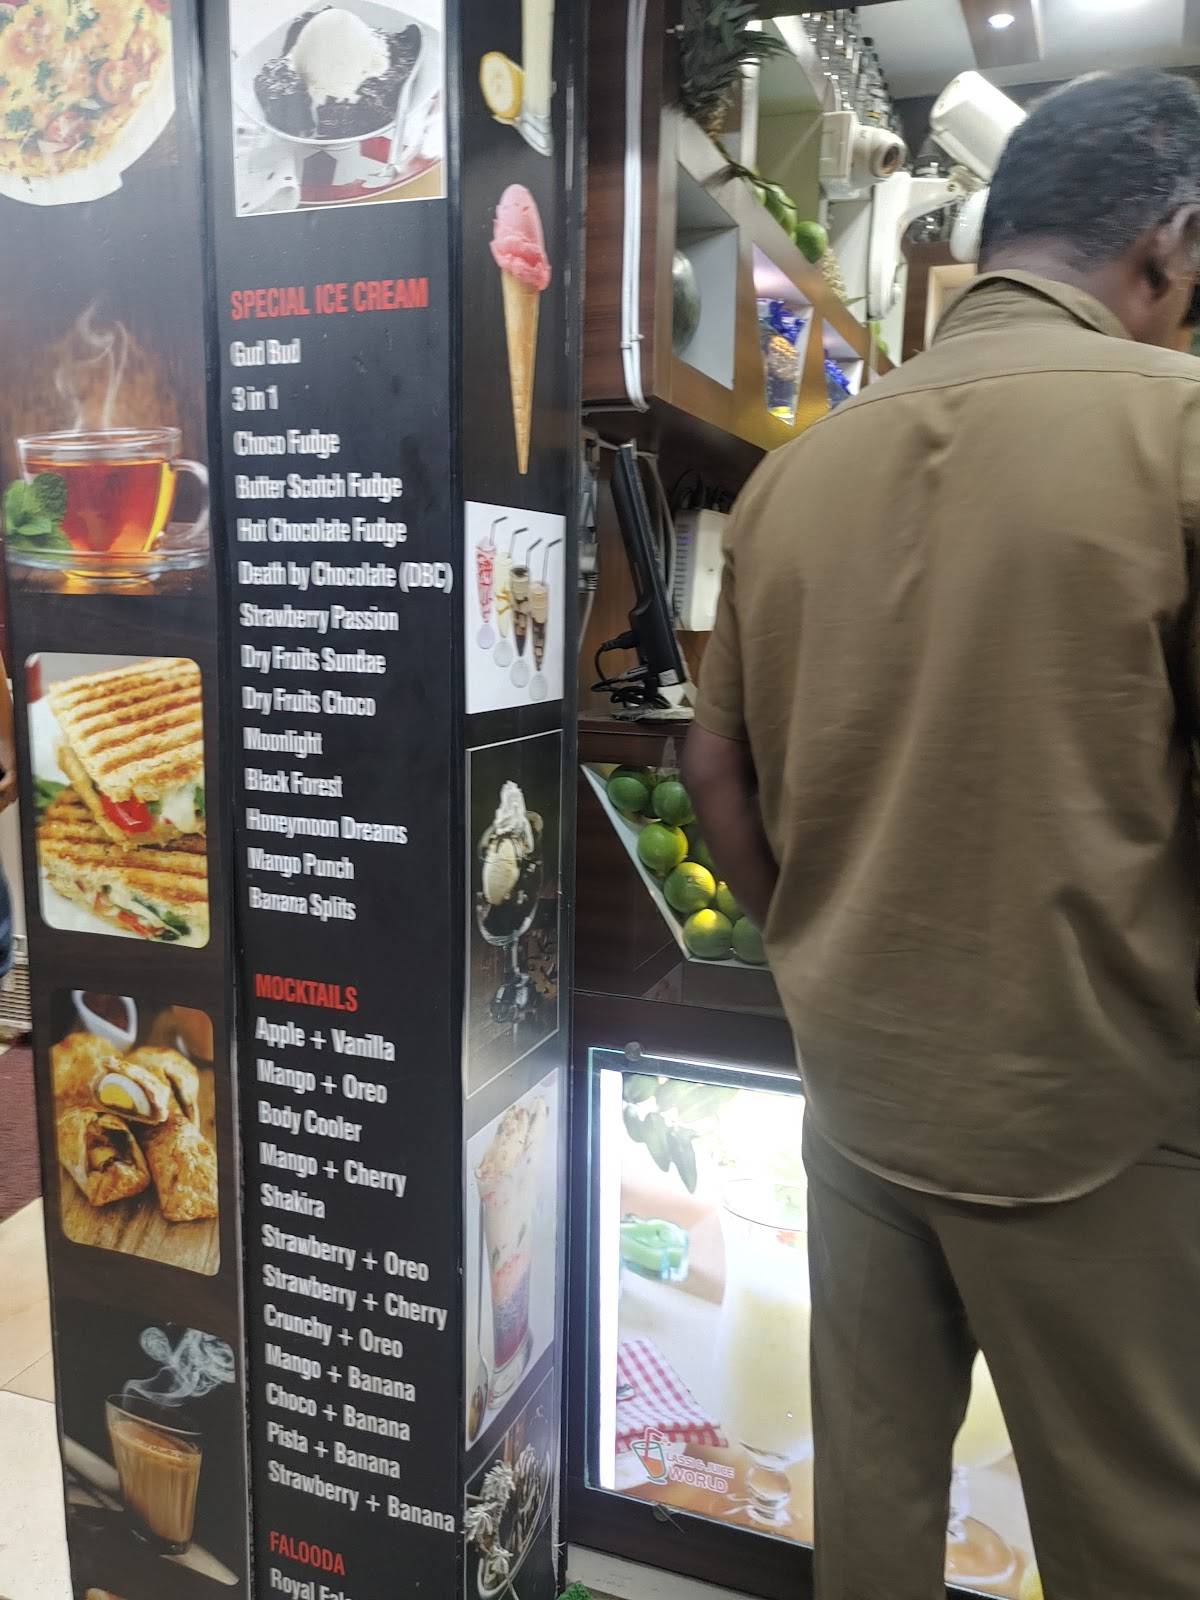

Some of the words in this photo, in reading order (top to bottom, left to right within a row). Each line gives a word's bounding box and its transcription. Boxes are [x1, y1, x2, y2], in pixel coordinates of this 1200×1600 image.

[230, 287, 310, 320] SPECIAL
[316, 283, 349, 314] ICE
[353, 277, 429, 313] CREAM
[231, 386, 246, 411] 3
[246, 386, 266, 410] in
[265, 385, 278, 410] 1
[233, 430, 286, 456] Choco
[286, 429, 341, 459] Fudge
[235, 474, 287, 499] Butter
[286, 473, 346, 499] Scotch
[347, 472, 403, 502] Fudge
[236, 518, 268, 542] Hot
[267, 517, 351, 542] Chocolate
[352, 517, 407, 548] Fudge
[238, 560, 287, 585] Death
[287, 561, 310, 591] by
[311, 561, 397, 587] Chocolate
[399, 562, 453, 594] (DBC)
[240, 602, 330, 634] Strawberry
[330, 604, 399, 631] Passion
[240, 644, 272, 674] Dry
[272, 646, 320, 672] Fruits
[321, 647, 387, 674] Sundae
[242, 686, 272, 716] Dry
[272, 688, 321, 713] Fruits
[321, 690, 376, 716] Choco
[243, 726, 323, 758] Moonlight
[244, 768, 290, 793] Black
[290, 771, 343, 798] Forest
[246, 807, 339, 839] Honeymoon
[340, 816, 408, 844] Dreams
[247, 847, 302, 878] Mango
[302, 852, 354, 880] Punch
[249, 886, 308, 915] Banana
[310, 892, 356, 922] Splits
[256, 973, 358, 1012] MOCKTAILS
[256, 1016, 305, 1049] Apple
[310, 1030, 326, 1050] +
[330, 1028, 396, 1061] Vanilla
[256, 1058, 316, 1094] Mango
[320, 1075, 337, 1095] +
[342, 1074, 387, 1104] Oreo
[258, 1100, 302, 1135] Body
[304, 1110, 362, 1142] Cooler
[260, 1142, 318, 1178] Mango
[322, 1160, 339, 1179] +
[344, 1159, 407, 1198] Cherry
[260, 1182, 325, 1219] Shakira
[261, 1224, 356, 1271] Strawberry
[362, 1252, 378, 1270] +
[384, 1250, 429, 1282] Oreo
[262, 1264, 357, 1312] Strawberry
[363, 1293, 379, 1312] +
[384, 1292, 448, 1332] Cherry
[264, 1304, 333, 1347] Crunchy
[337, 1328, 353, 1346] +
[359, 1327, 403, 1359] Oreo
[265, 1342, 321, 1380] Mango
[326, 1365, 342, 1384] +
[348, 1365, 416, 1402] Banana
[266, 1382, 317, 1417] Choco
[322, 1403, 338, 1422] +
[343, 1404, 410, 1441] Banana
[267, 1421, 308, 1453] Pista
[313, 1440, 328, 1458] +
[334, 1442, 400, 1479] Banana
[268, 1460, 359, 1512] Strawberry
[366, 1494, 381, 1513] +
[387, 1495, 455, 1533] Banana
[670, 1466, 728, 1493] WORLD
[270, 1531, 345, 1576] FALOODA
[269, 1567, 315, 1600] Royal
